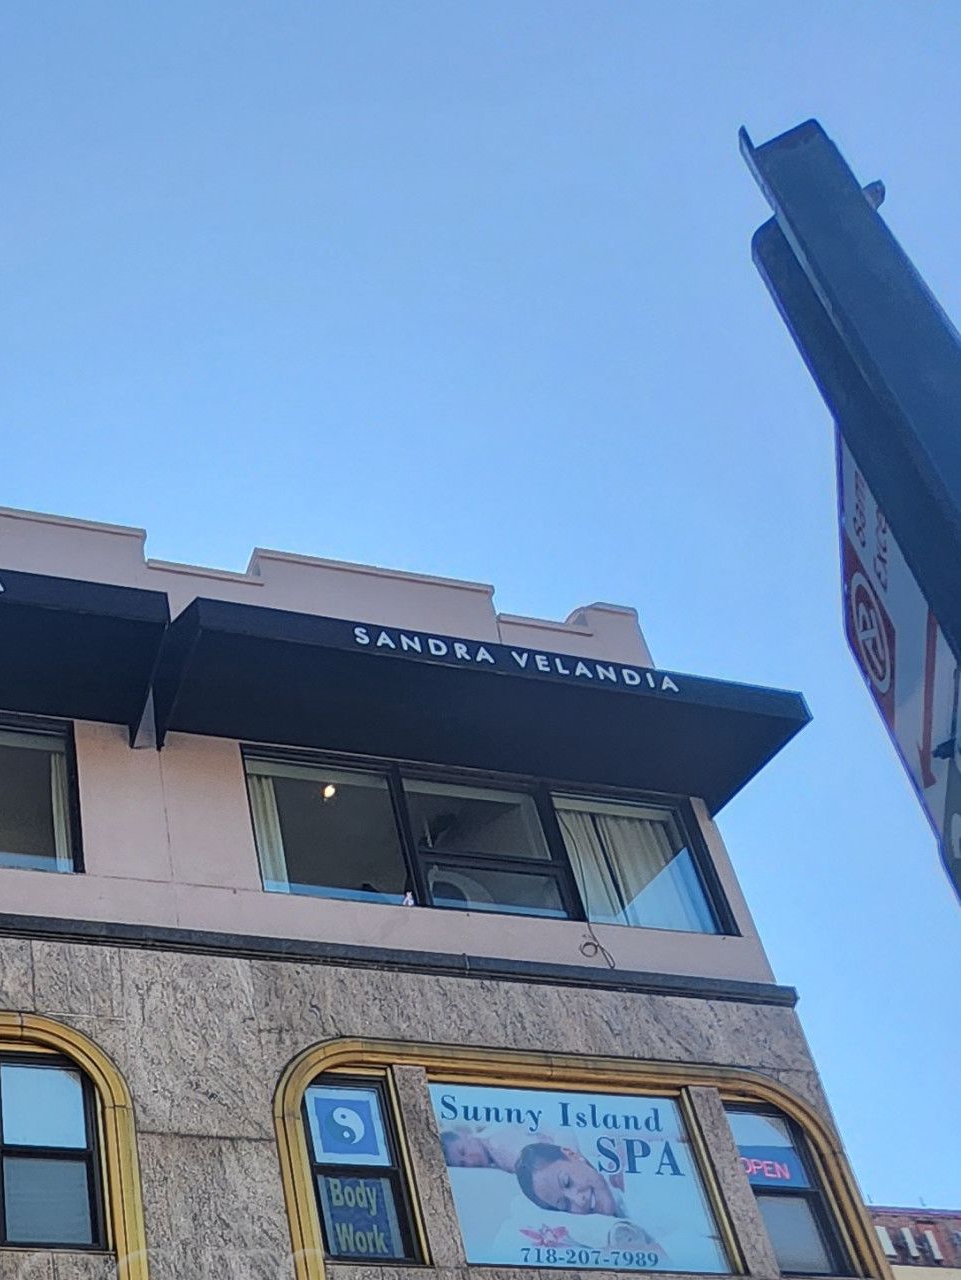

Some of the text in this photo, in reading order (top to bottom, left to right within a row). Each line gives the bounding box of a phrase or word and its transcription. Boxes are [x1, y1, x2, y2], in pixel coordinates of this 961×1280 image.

[353, 626, 680, 694] SANDRA VELANDIA
[441, 1094, 664, 1132] Sunny Island
[596, 1136, 686, 1177] SPA
[328, 1177, 378, 1217] Body
[335, 1222, 389, 1254] Work
[520, 1248, 659, 1268] 718-207-7989
